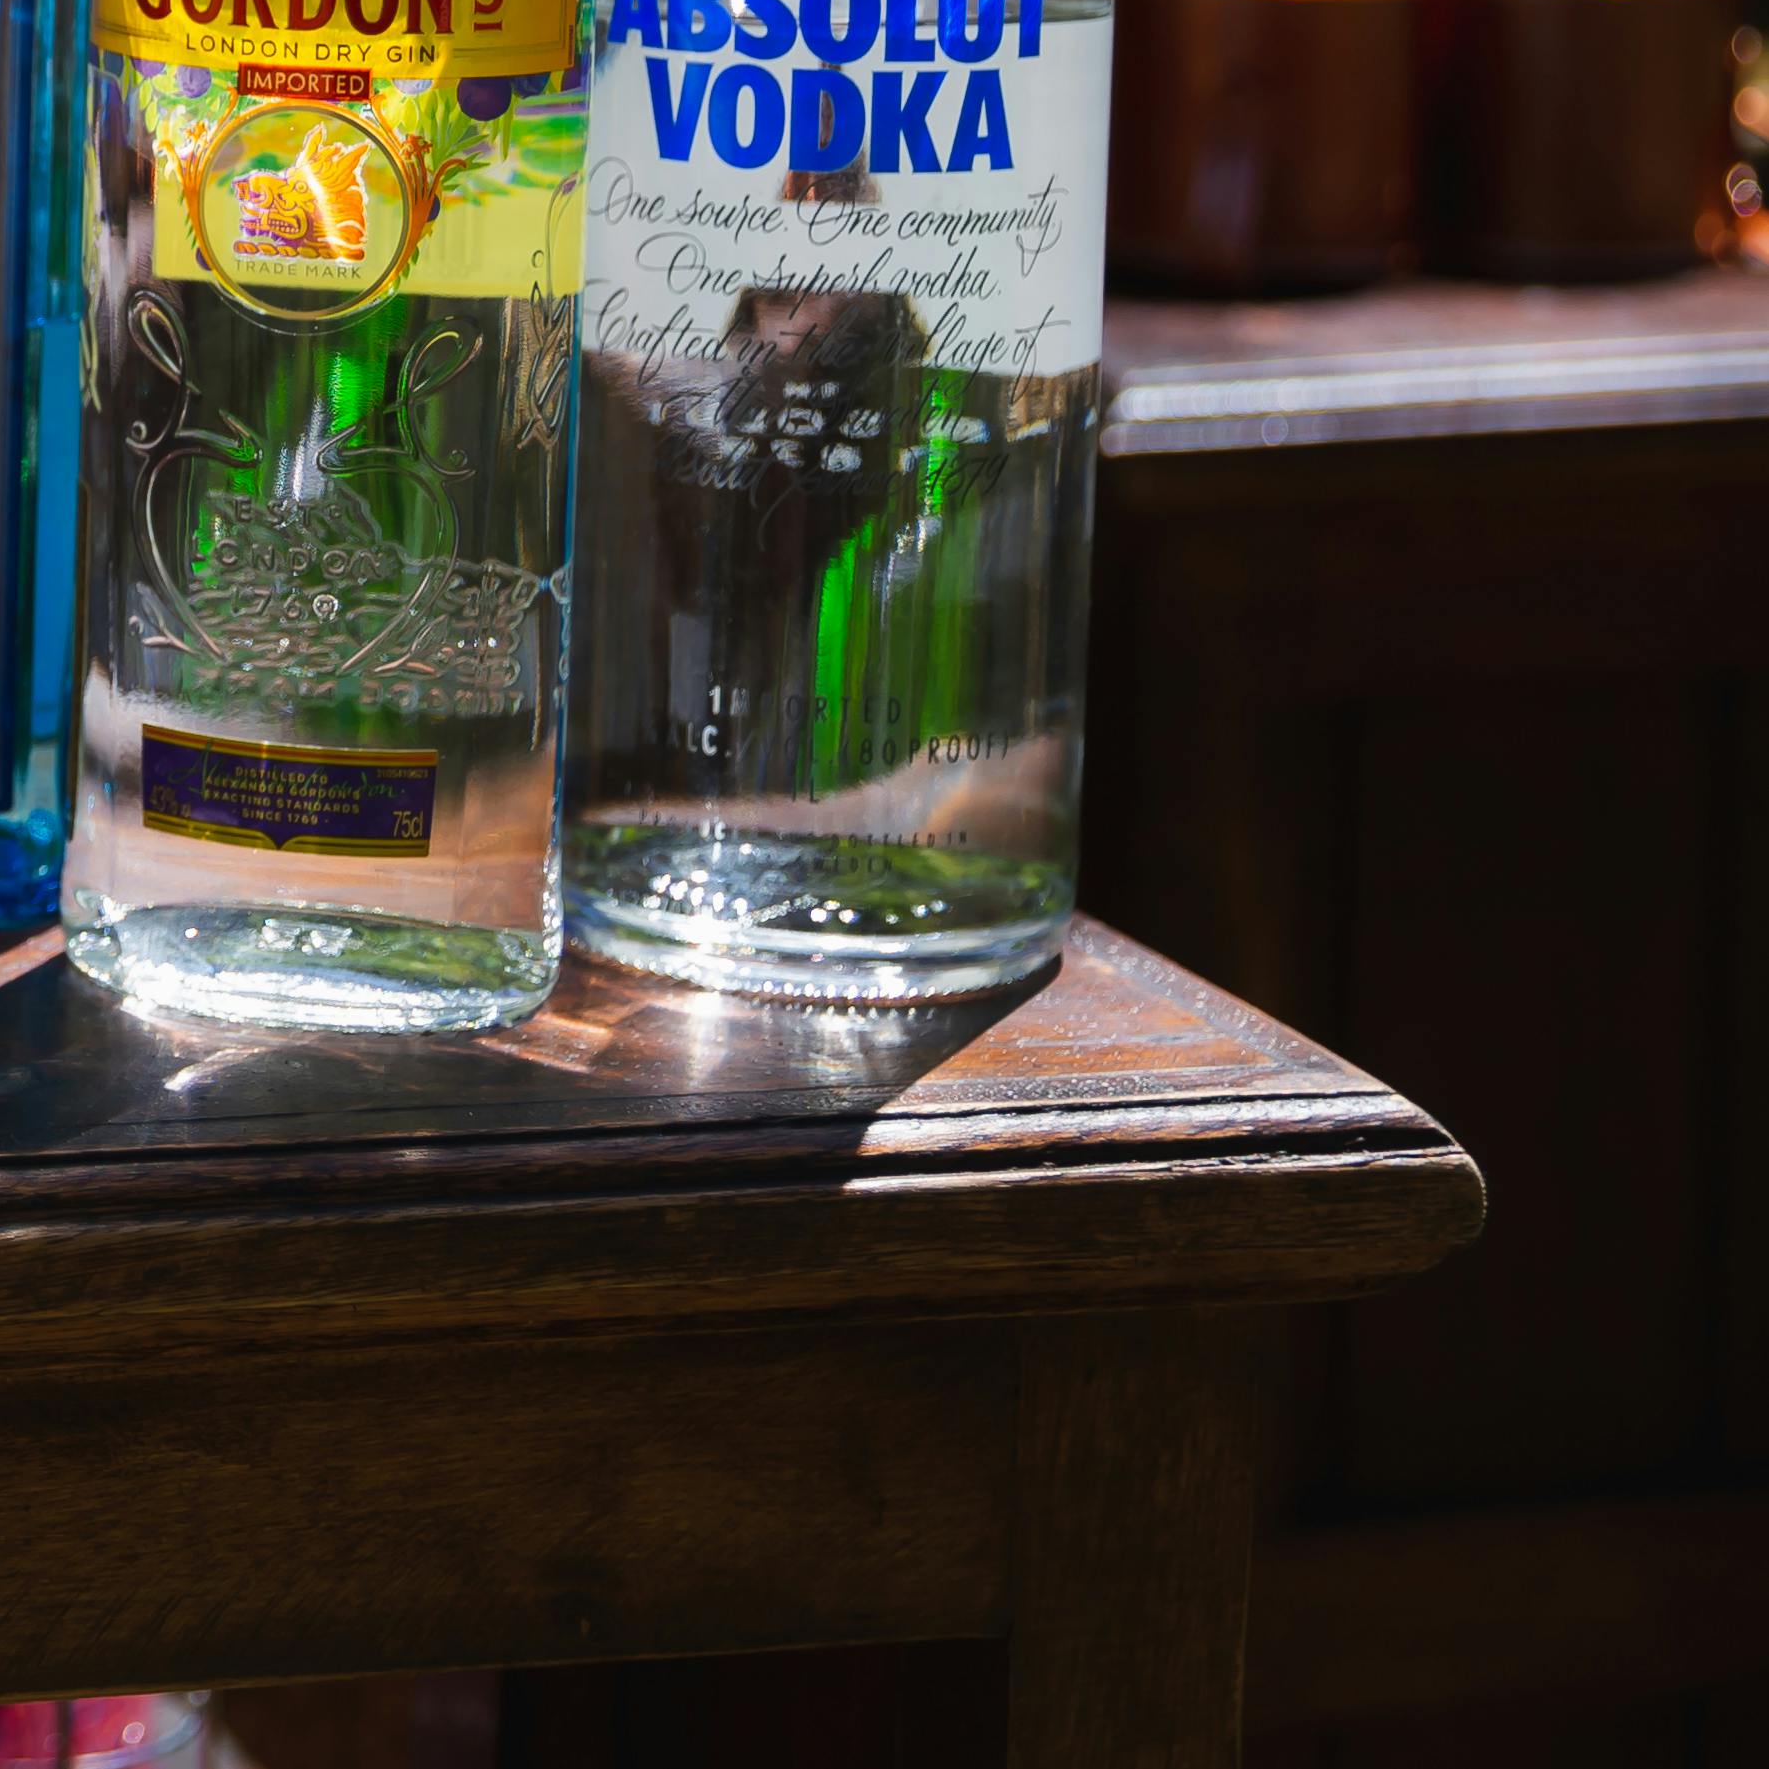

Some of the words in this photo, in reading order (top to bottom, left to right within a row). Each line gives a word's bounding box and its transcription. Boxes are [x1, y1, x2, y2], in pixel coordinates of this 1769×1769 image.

[185, 34, 300, 60] LONDON
[315, 42, 372, 63] DRY
[386, 45, 437, 63] GIN
[245, 70, 366, 96] IMPORTED
[645, 55, 1015, 174] VODKA
[588, 157, 665, 226] One
[796, 175, 891, 247] One
[234, 258, 300, 277] TRADE
[305, 260, 362, 281] MARK
[634, 231, 742, 295] One
[205, 775, 285, 796] ALEXANDER
[235, 765, 305, 785] DISTILLED
[310, 773, 329, 785] TO
[205, 788, 271, 808] EXACTING
[276, 797, 361, 815] STANDARDS
[241, 808, 282, 823] SINCE
[392, 809, 424, 838] 75cl
